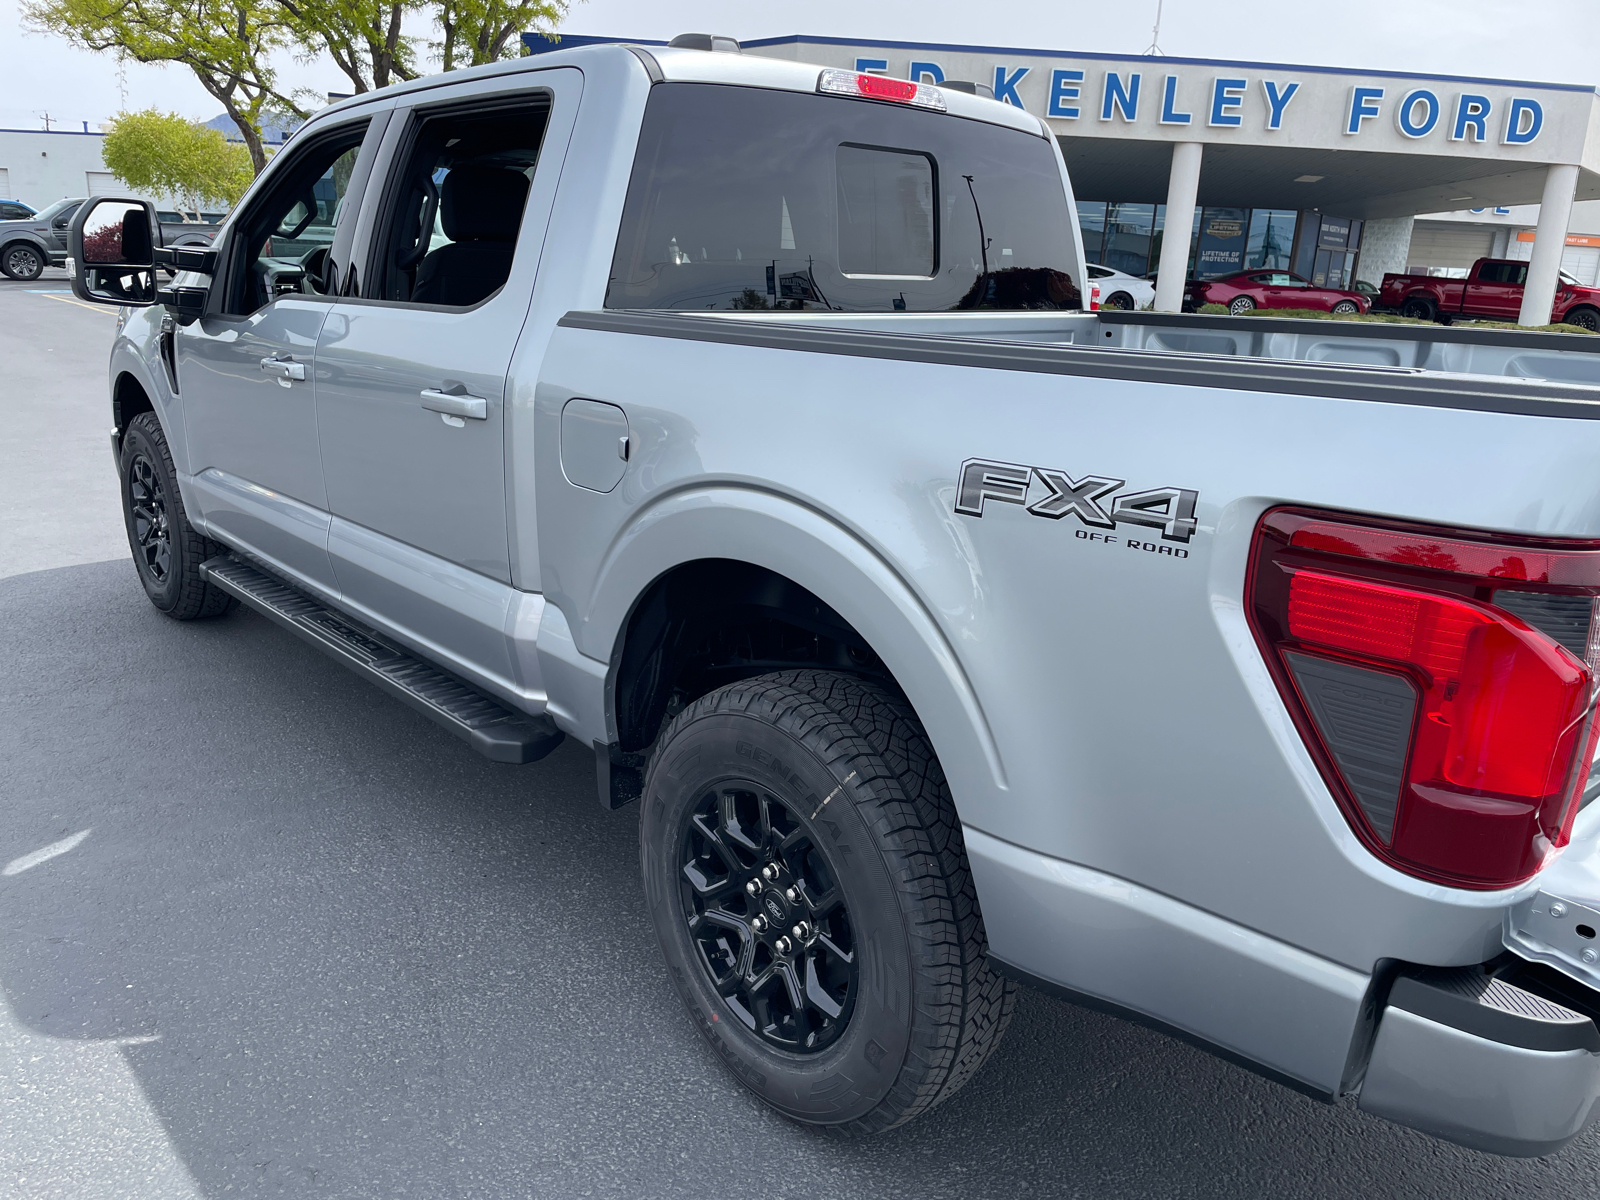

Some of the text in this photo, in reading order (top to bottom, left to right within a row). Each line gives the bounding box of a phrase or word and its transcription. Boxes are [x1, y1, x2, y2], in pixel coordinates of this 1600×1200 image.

[993, 66, 1299, 128] KENLEY
[1346, 87, 1543, 144] FORD
[953, 457, 1200, 544] FX4
[1074, 529, 1190, 559] OFF ROAD
[317, 618, 384, 653] FORD
[1321, 683, 1406, 709] FORD
[735, 739, 854, 867] GENERAL
